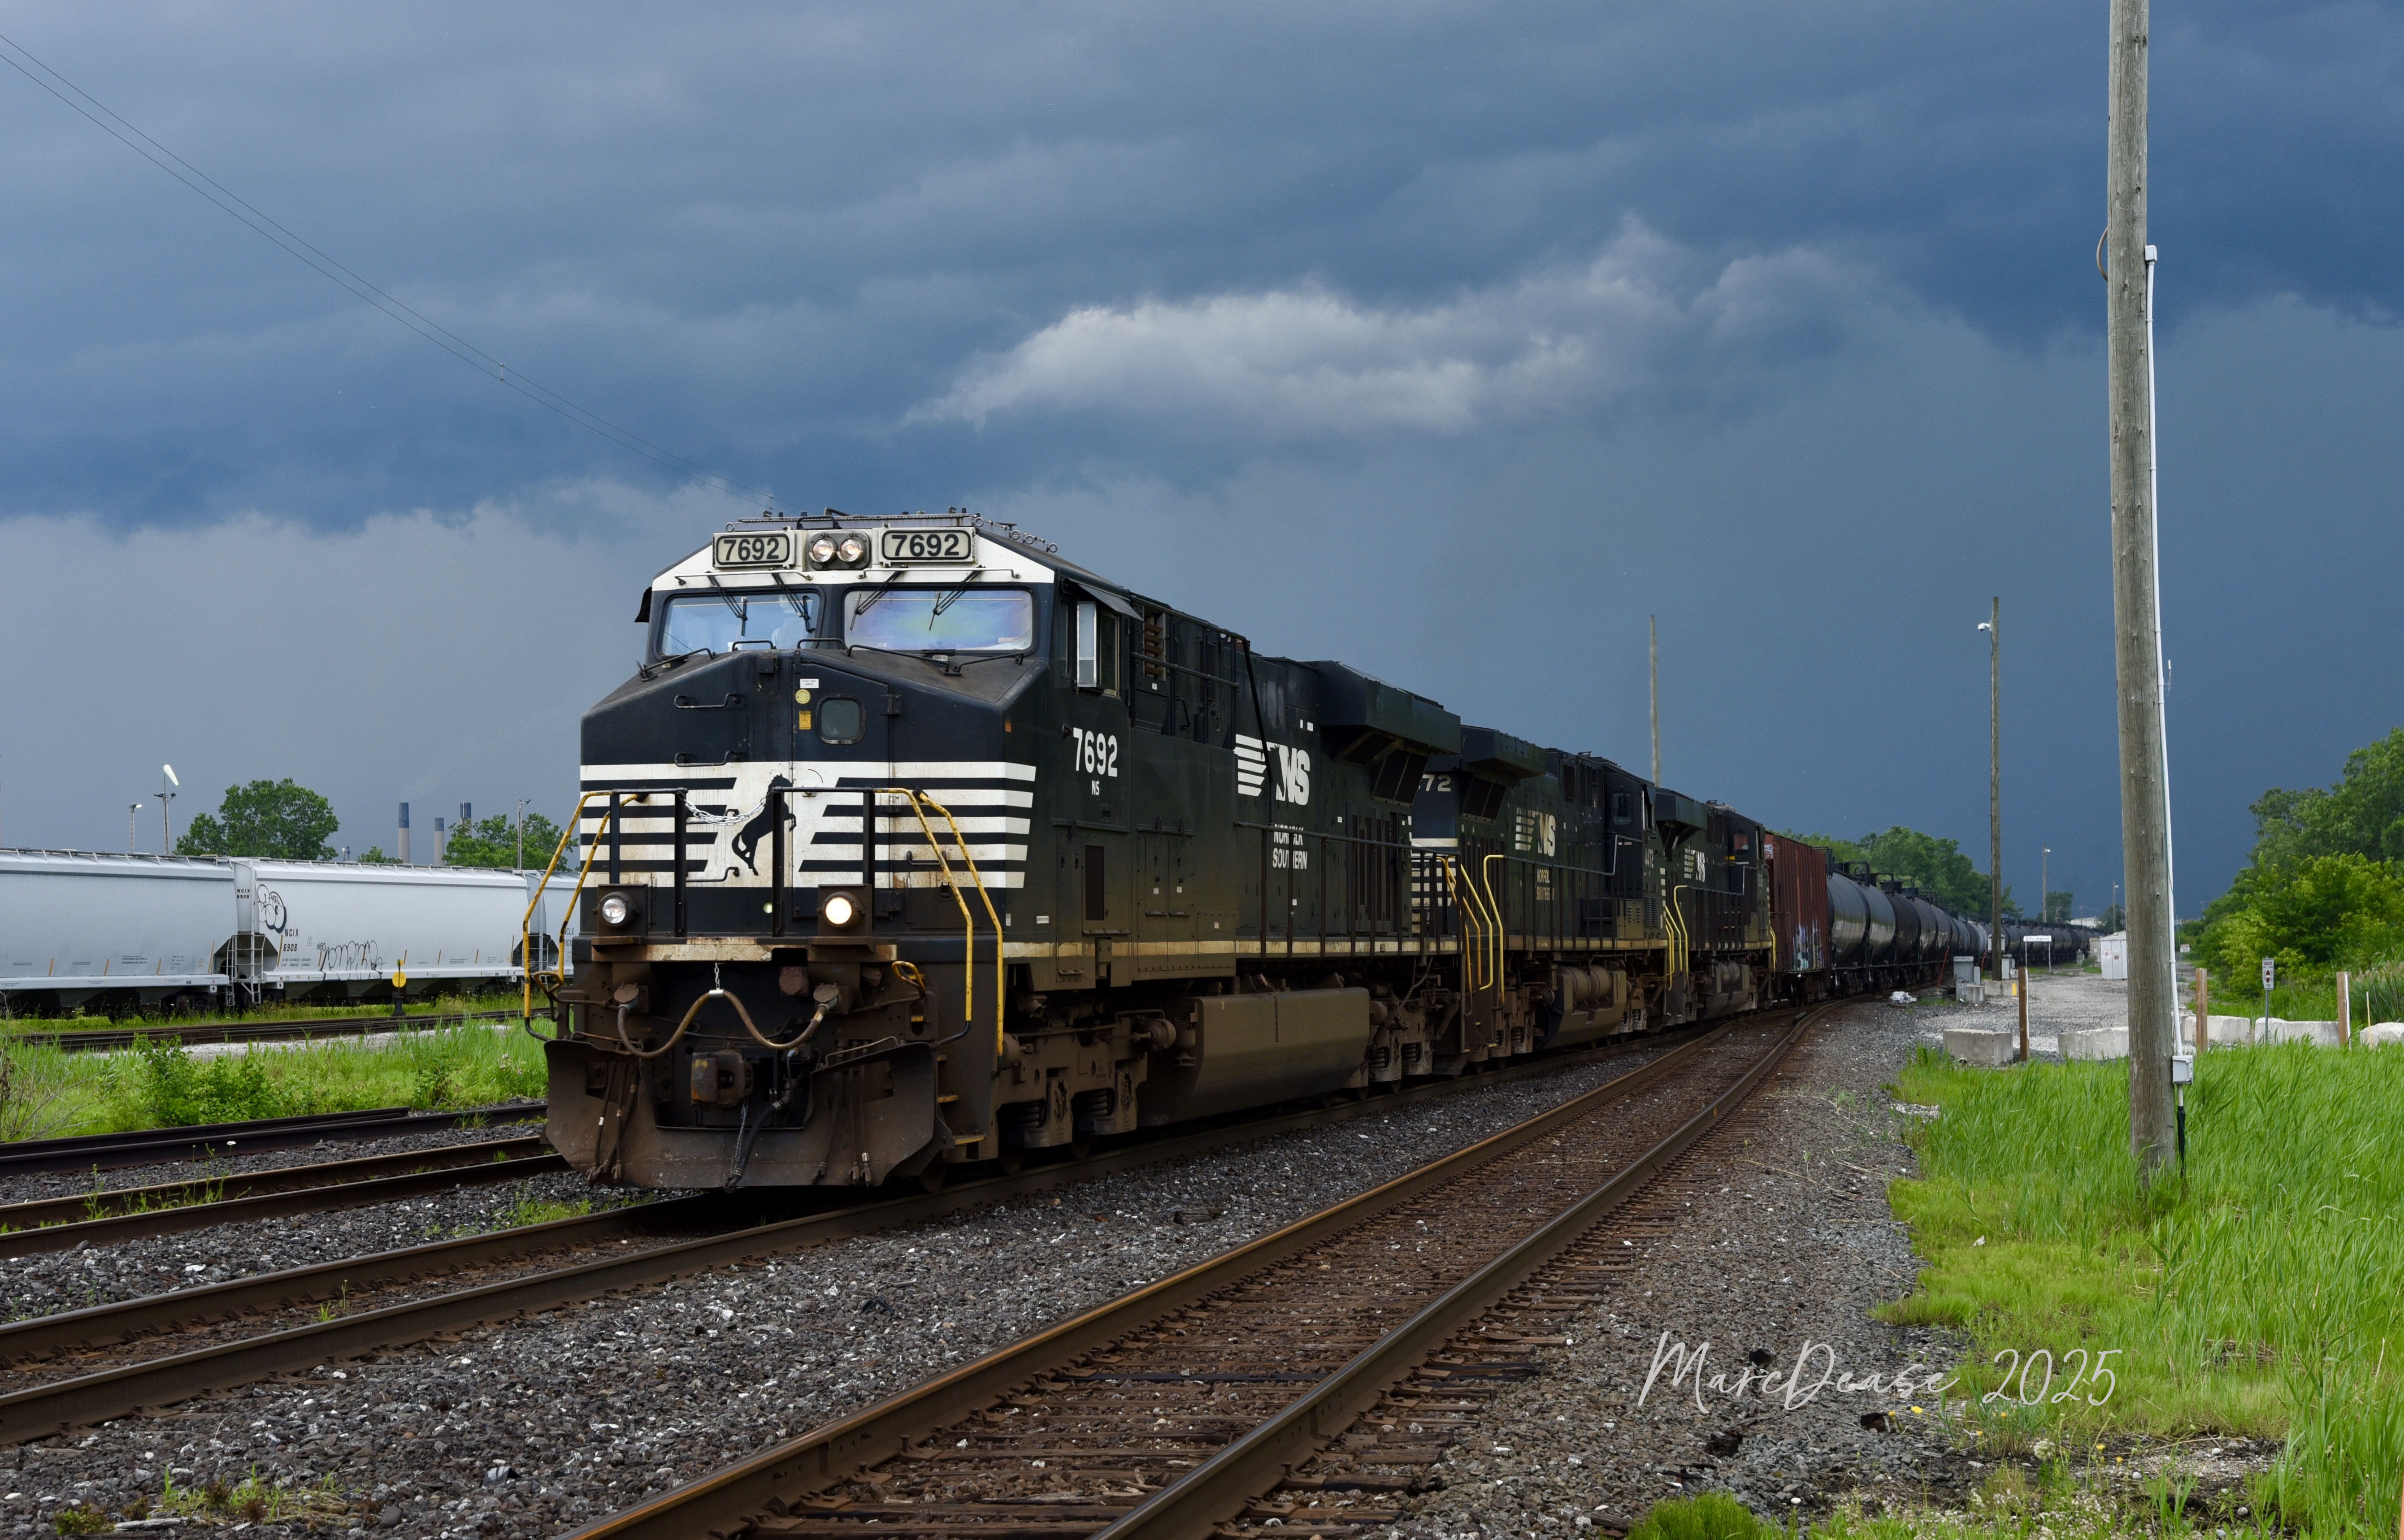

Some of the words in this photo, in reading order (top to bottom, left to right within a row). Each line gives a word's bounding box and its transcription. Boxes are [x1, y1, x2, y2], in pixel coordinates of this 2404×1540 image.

[724, 538, 779, 561] 7692
[892, 534, 959, 556] 7692
[1073, 727, 1117, 777] 7692
[1276, 744, 1310, 805] NS
[1418, 775, 1451, 792] 72
[1092, 780, 1099, 795] NS
[1274, 824, 1304, 846] NOROLK
[1538, 812, 1556, 857] NS
[1645, 848, 1653, 868] 4472
[1537, 869, 1550, 883] NORFOL
[285, 928, 299, 937] NCIX
